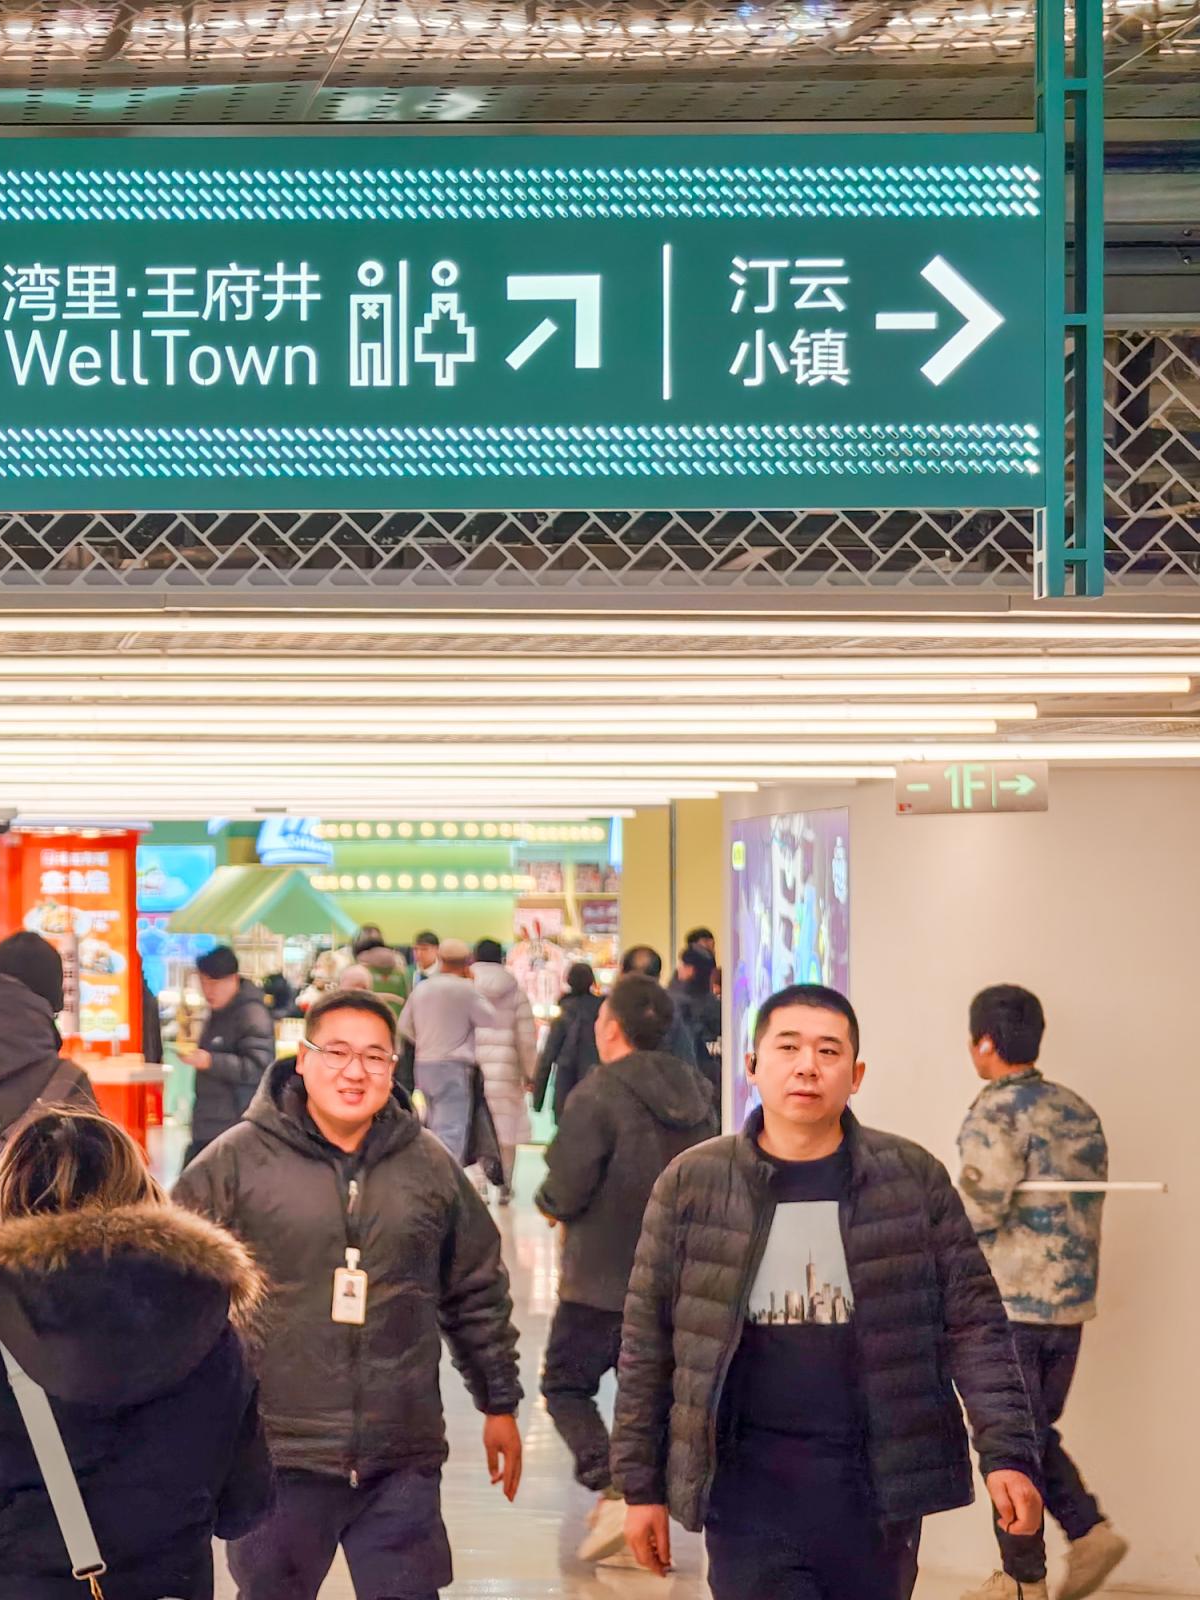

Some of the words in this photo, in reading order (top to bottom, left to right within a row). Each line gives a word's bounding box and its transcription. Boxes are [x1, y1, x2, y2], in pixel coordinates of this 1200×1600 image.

[1, 262, 322, 322] 湾里·王府井
[729, 255, 850, 315] 汀云
[3, 329, 318, 387] WellTown
[729, 328, 850, 387] 小镇
